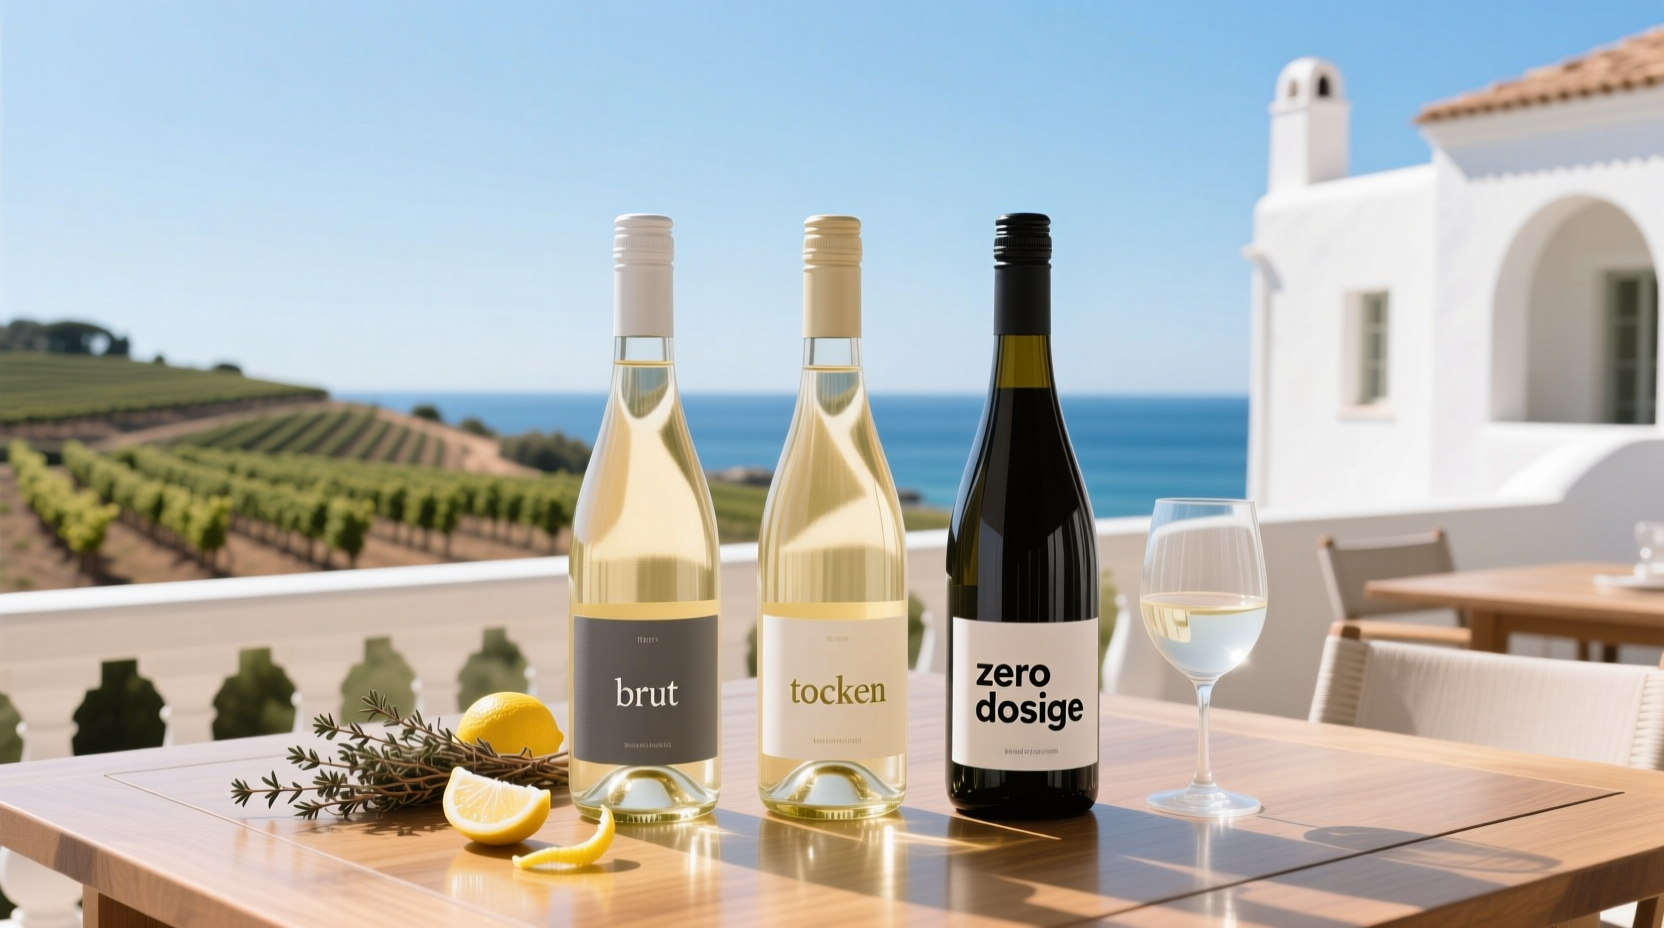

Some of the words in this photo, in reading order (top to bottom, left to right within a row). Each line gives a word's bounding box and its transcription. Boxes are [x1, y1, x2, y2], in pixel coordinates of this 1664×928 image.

[790, 675, 887, 705] tocken
[976, 662, 1051, 688] zero
[614, 677, 679, 708] brut
[976, 691, 1084, 732] dosige
